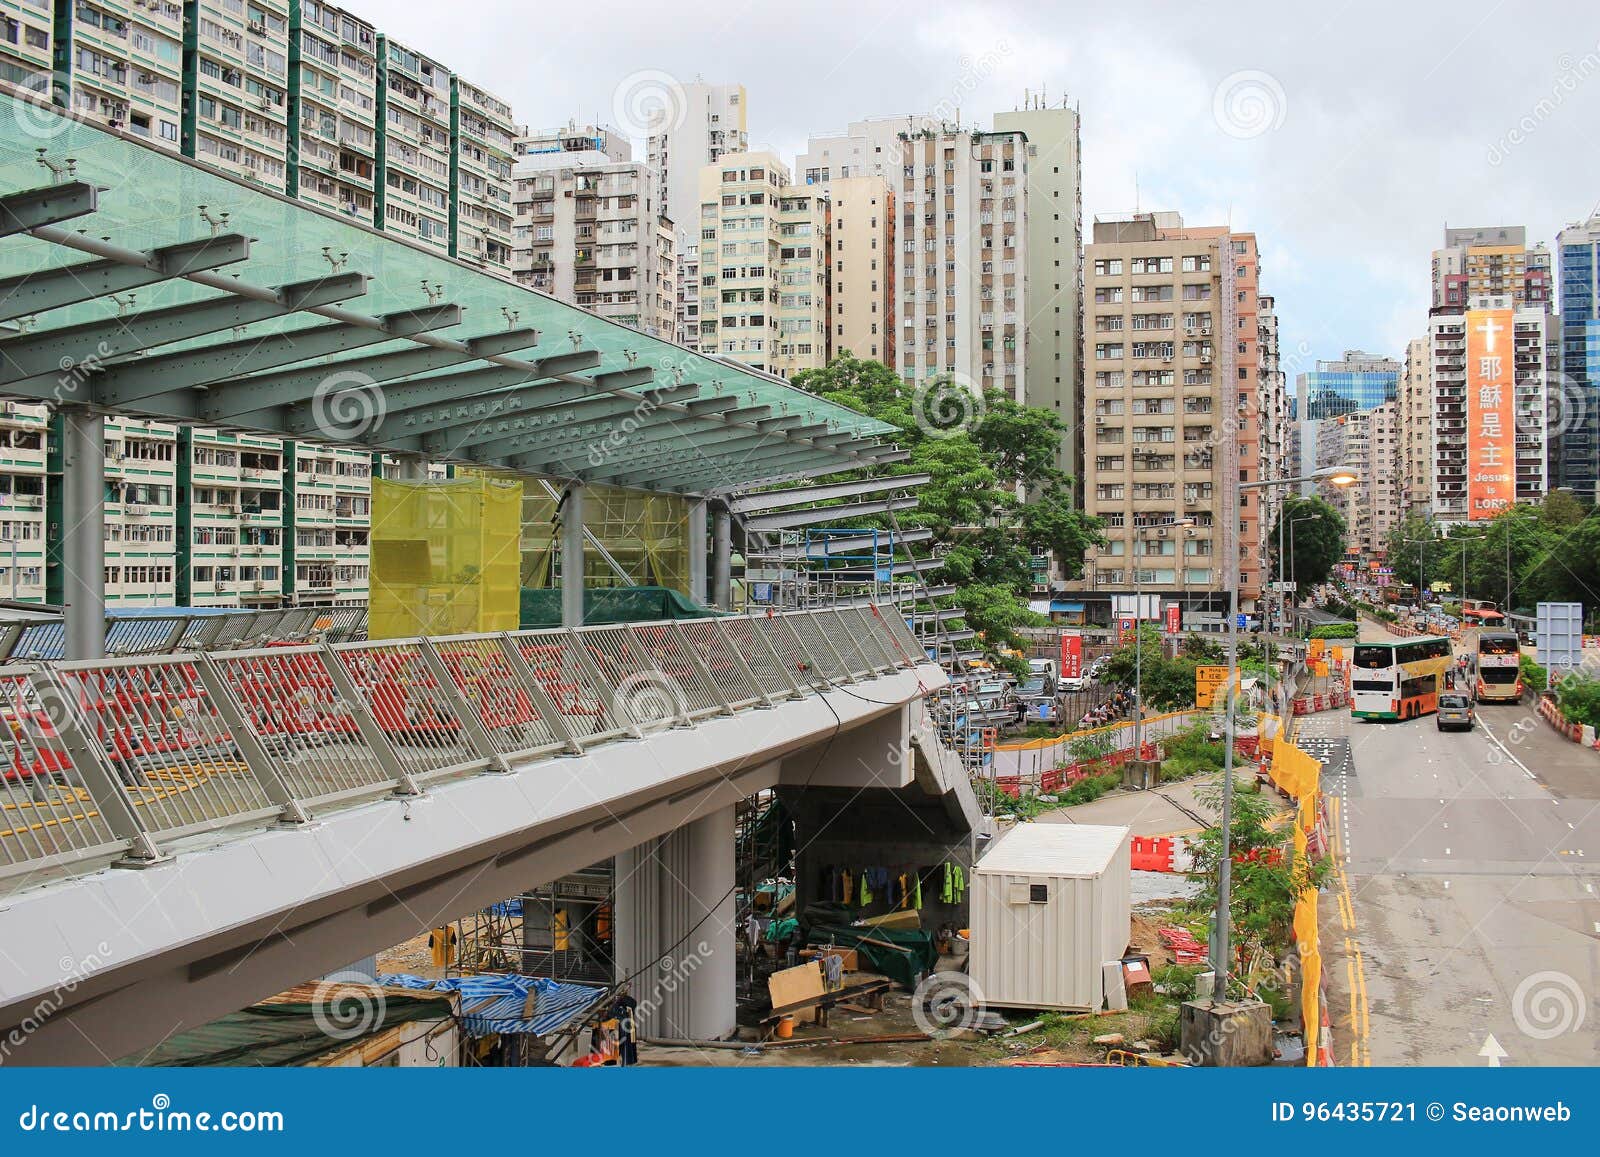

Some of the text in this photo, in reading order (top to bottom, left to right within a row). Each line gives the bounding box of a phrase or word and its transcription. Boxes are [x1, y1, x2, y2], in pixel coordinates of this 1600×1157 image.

[1479, 356, 1503, 466] 耶穌是主
[1474, 473, 1509, 482] Jesus
